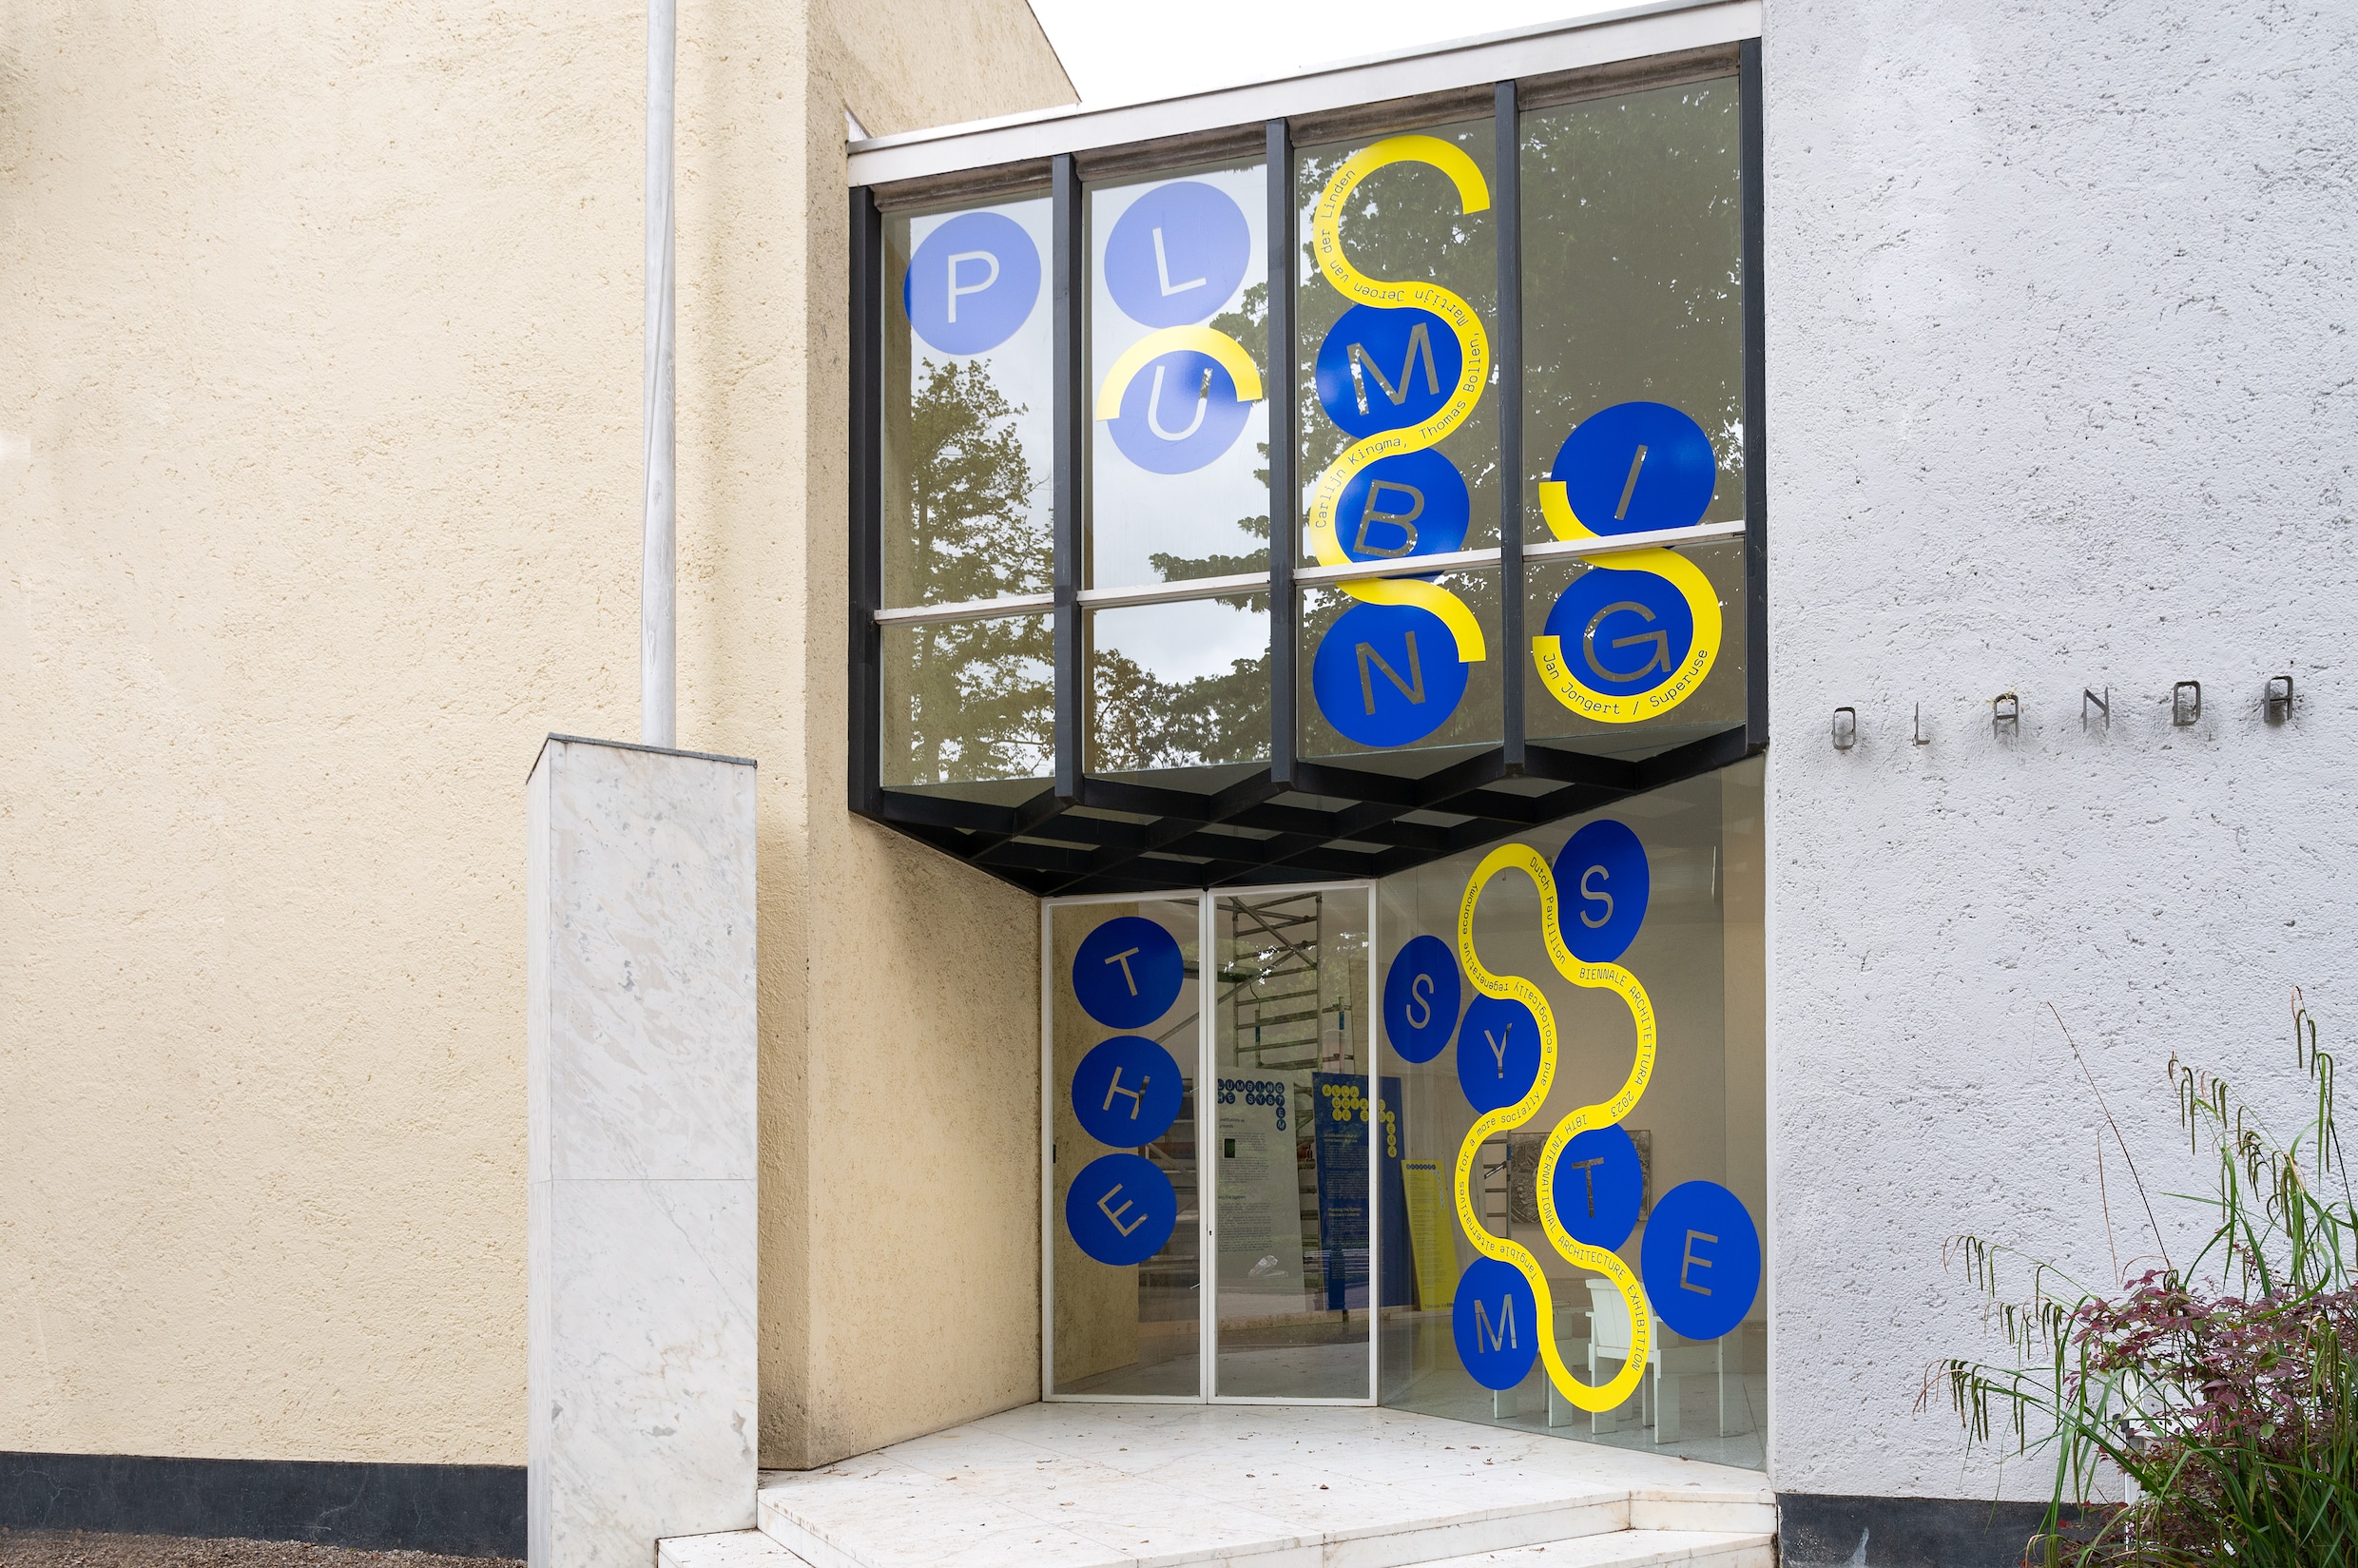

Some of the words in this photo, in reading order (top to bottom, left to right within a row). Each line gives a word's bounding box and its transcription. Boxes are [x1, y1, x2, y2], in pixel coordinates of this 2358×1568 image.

[1321, 169, 1356, 219] Linden
[1321, 228, 1332, 254] der
[1329, 259, 1349, 283] van
[1354, 281, 1405, 302] Jeroen
[1415, 289, 1470, 328] Martijn
[1462, 332, 1481, 393] Bollen,
[1419, 400, 1466, 440] Thomas
[1347, 437, 1407, 466] Kingma,
[1315, 468, 1346, 528] Carlijn
[1543, 652, 1560, 680] Jan
[1560, 682, 1620, 715] Jongert
[1650, 648, 1708, 707] Superuse
[1832, 674, 2294, 750] OLANDA
[1529, 856, 1550, 891] Dutch
[1462, 881, 1479, 935] economy
[1546, 897, 1566, 965] Pavillion
[1462, 941, 1509, 993] regenerative
[1579, 967, 1628, 987] BIENNALE
[1514, 980, 1553, 1054] ecologically
[1629, 986, 1653, 1085] ARCHITETTURA
[1540, 1061, 1552, 1086] and
[1500, 1091, 1541, 1124] socially
[1610, 1091, 1634, 1117] 2023
[1476, 1116, 1497, 1137] more
[1564, 1114, 1587, 1135] 18TH
[1459, 1152, 1470, 1172] for
[1541, 1134, 1563, 1234] INTERNATIONAL
[1459, 1181, 1496, 1251] alternatives
[1500, 1244, 1537, 1281] Tangible
[1557, 1235, 1627, 1281] ARCHITECTURE
[1628, 1284, 1646, 1372] EXHIBITION
